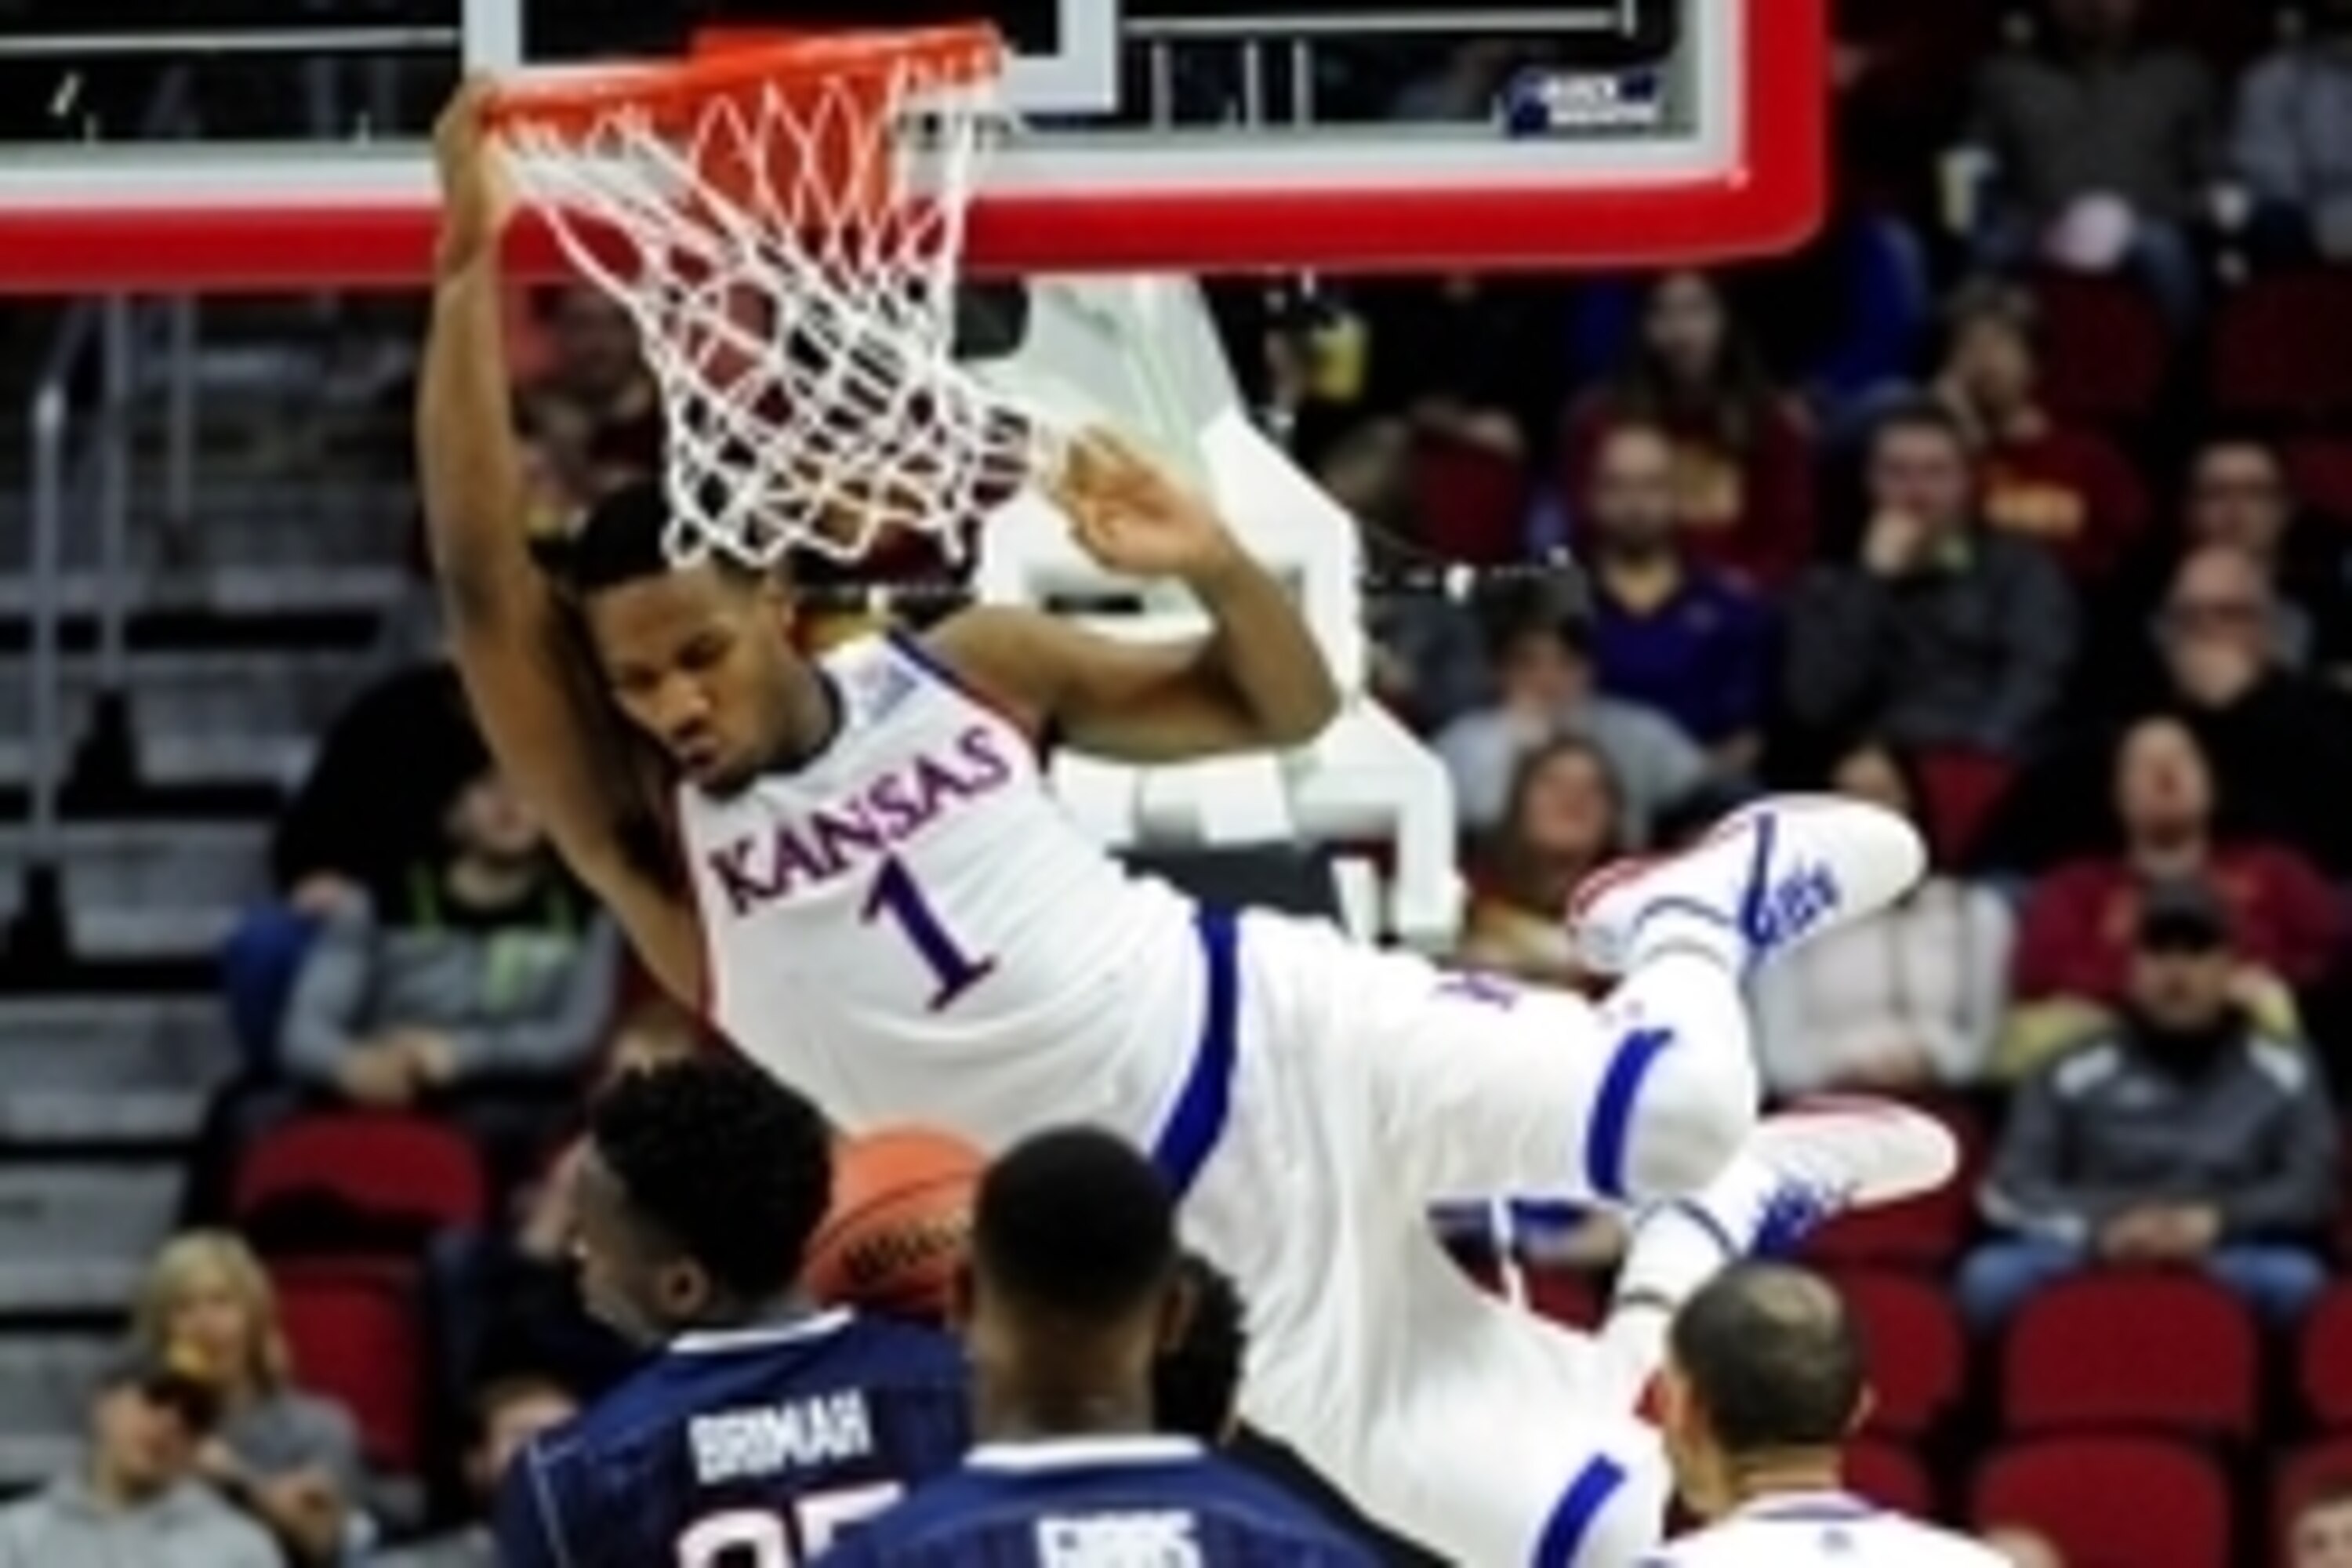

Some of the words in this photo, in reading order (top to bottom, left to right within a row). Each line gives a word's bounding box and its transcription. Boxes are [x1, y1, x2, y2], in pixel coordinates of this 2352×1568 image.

[709, 725, 1010, 915] KANSAS
[862, 852, 997, 1011] 1
[691, 1391, 871, 1483] BRIMAH
